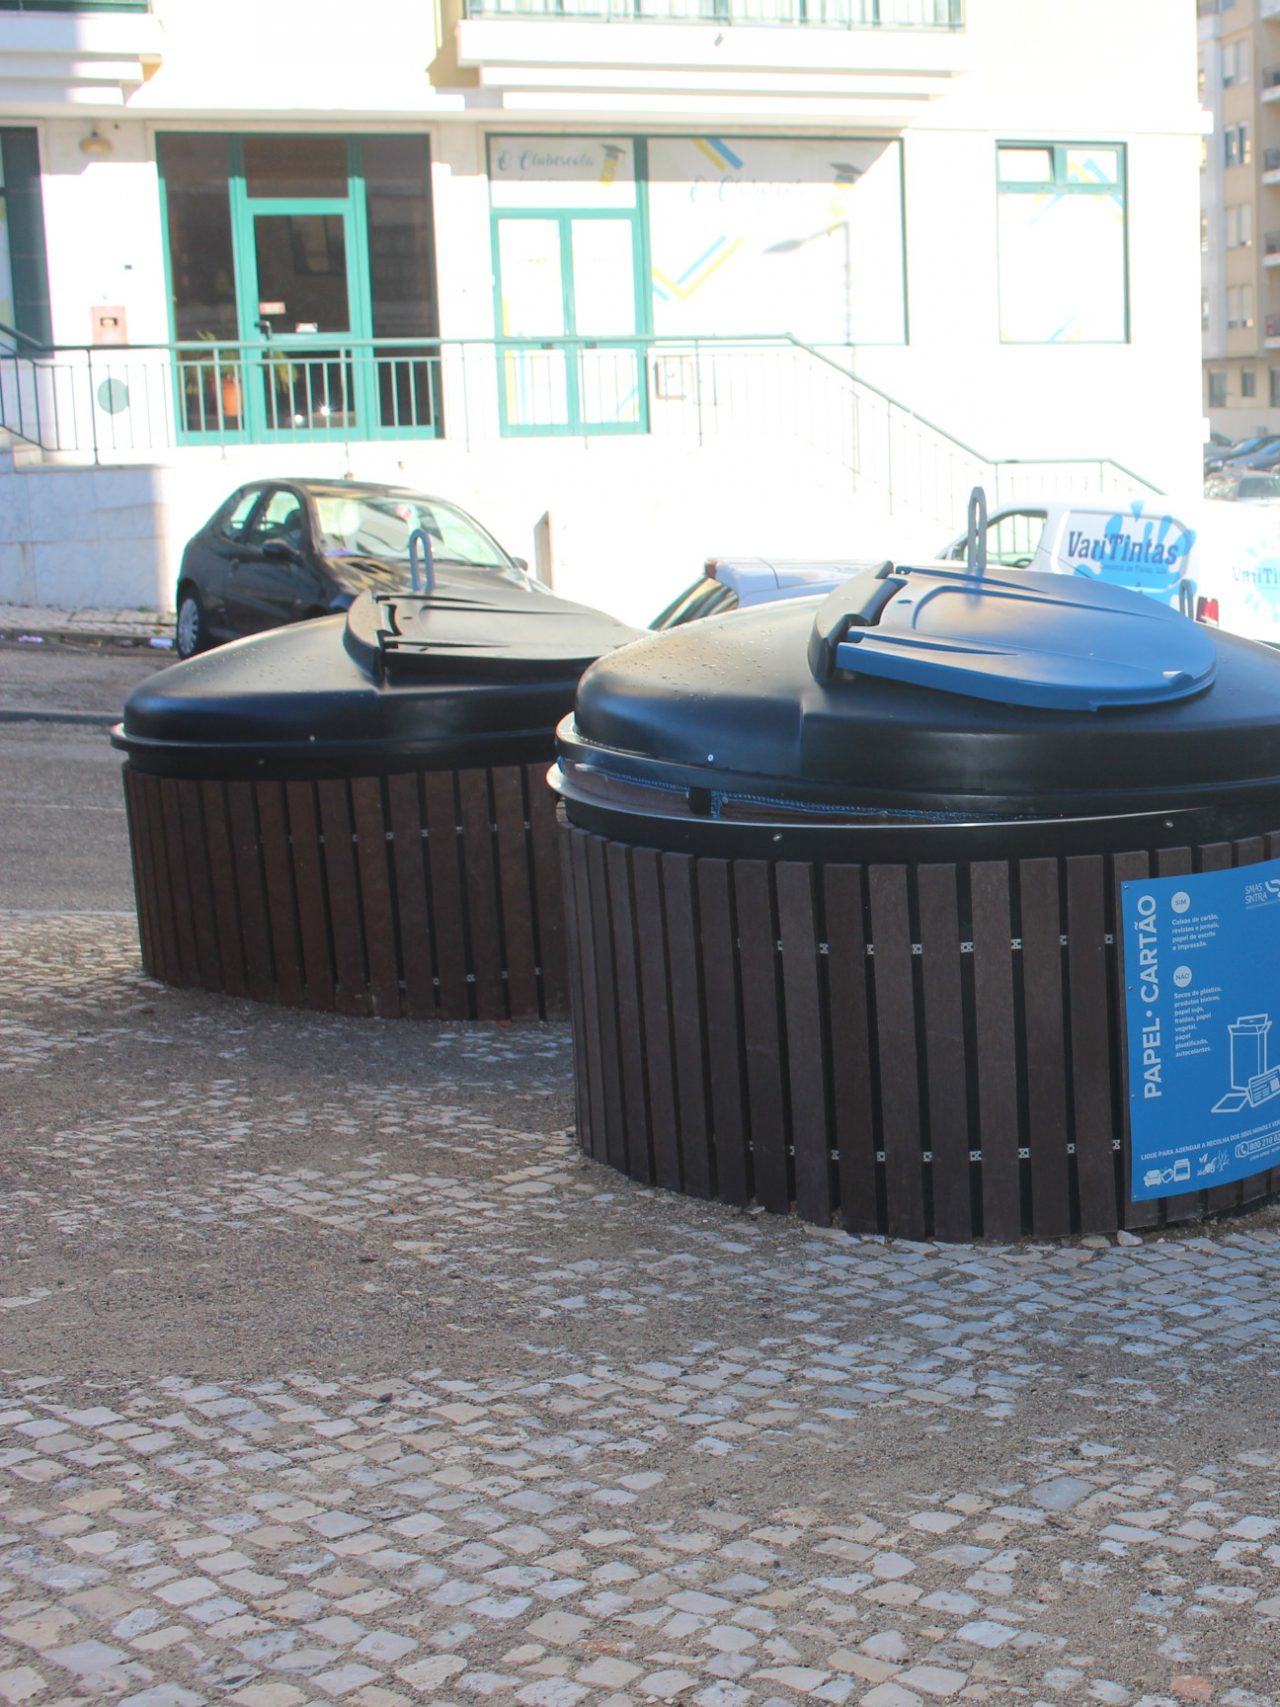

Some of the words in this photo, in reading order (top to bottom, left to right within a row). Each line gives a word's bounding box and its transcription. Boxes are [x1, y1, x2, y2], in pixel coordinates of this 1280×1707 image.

[1067, 530, 1179, 565] VariTintas
[1244, 883, 1263, 894] SMAS
[1174, 898, 1187, 906] SIM
[1244, 891, 1268, 905] SINTRA
[1134, 895, 1160, 1003] CARTÃO
[1175, 971, 1190, 981] NÃO
[1143, 1017, 1163, 1099] PAPEL
[1158, 1148, 1174, 1158] PARA
[1174, 1143, 1201, 1154] AGENDAR
[1206, 1136, 1230, 1148] RECOLHA
[1262, 1136, 1273, 1147] 210
